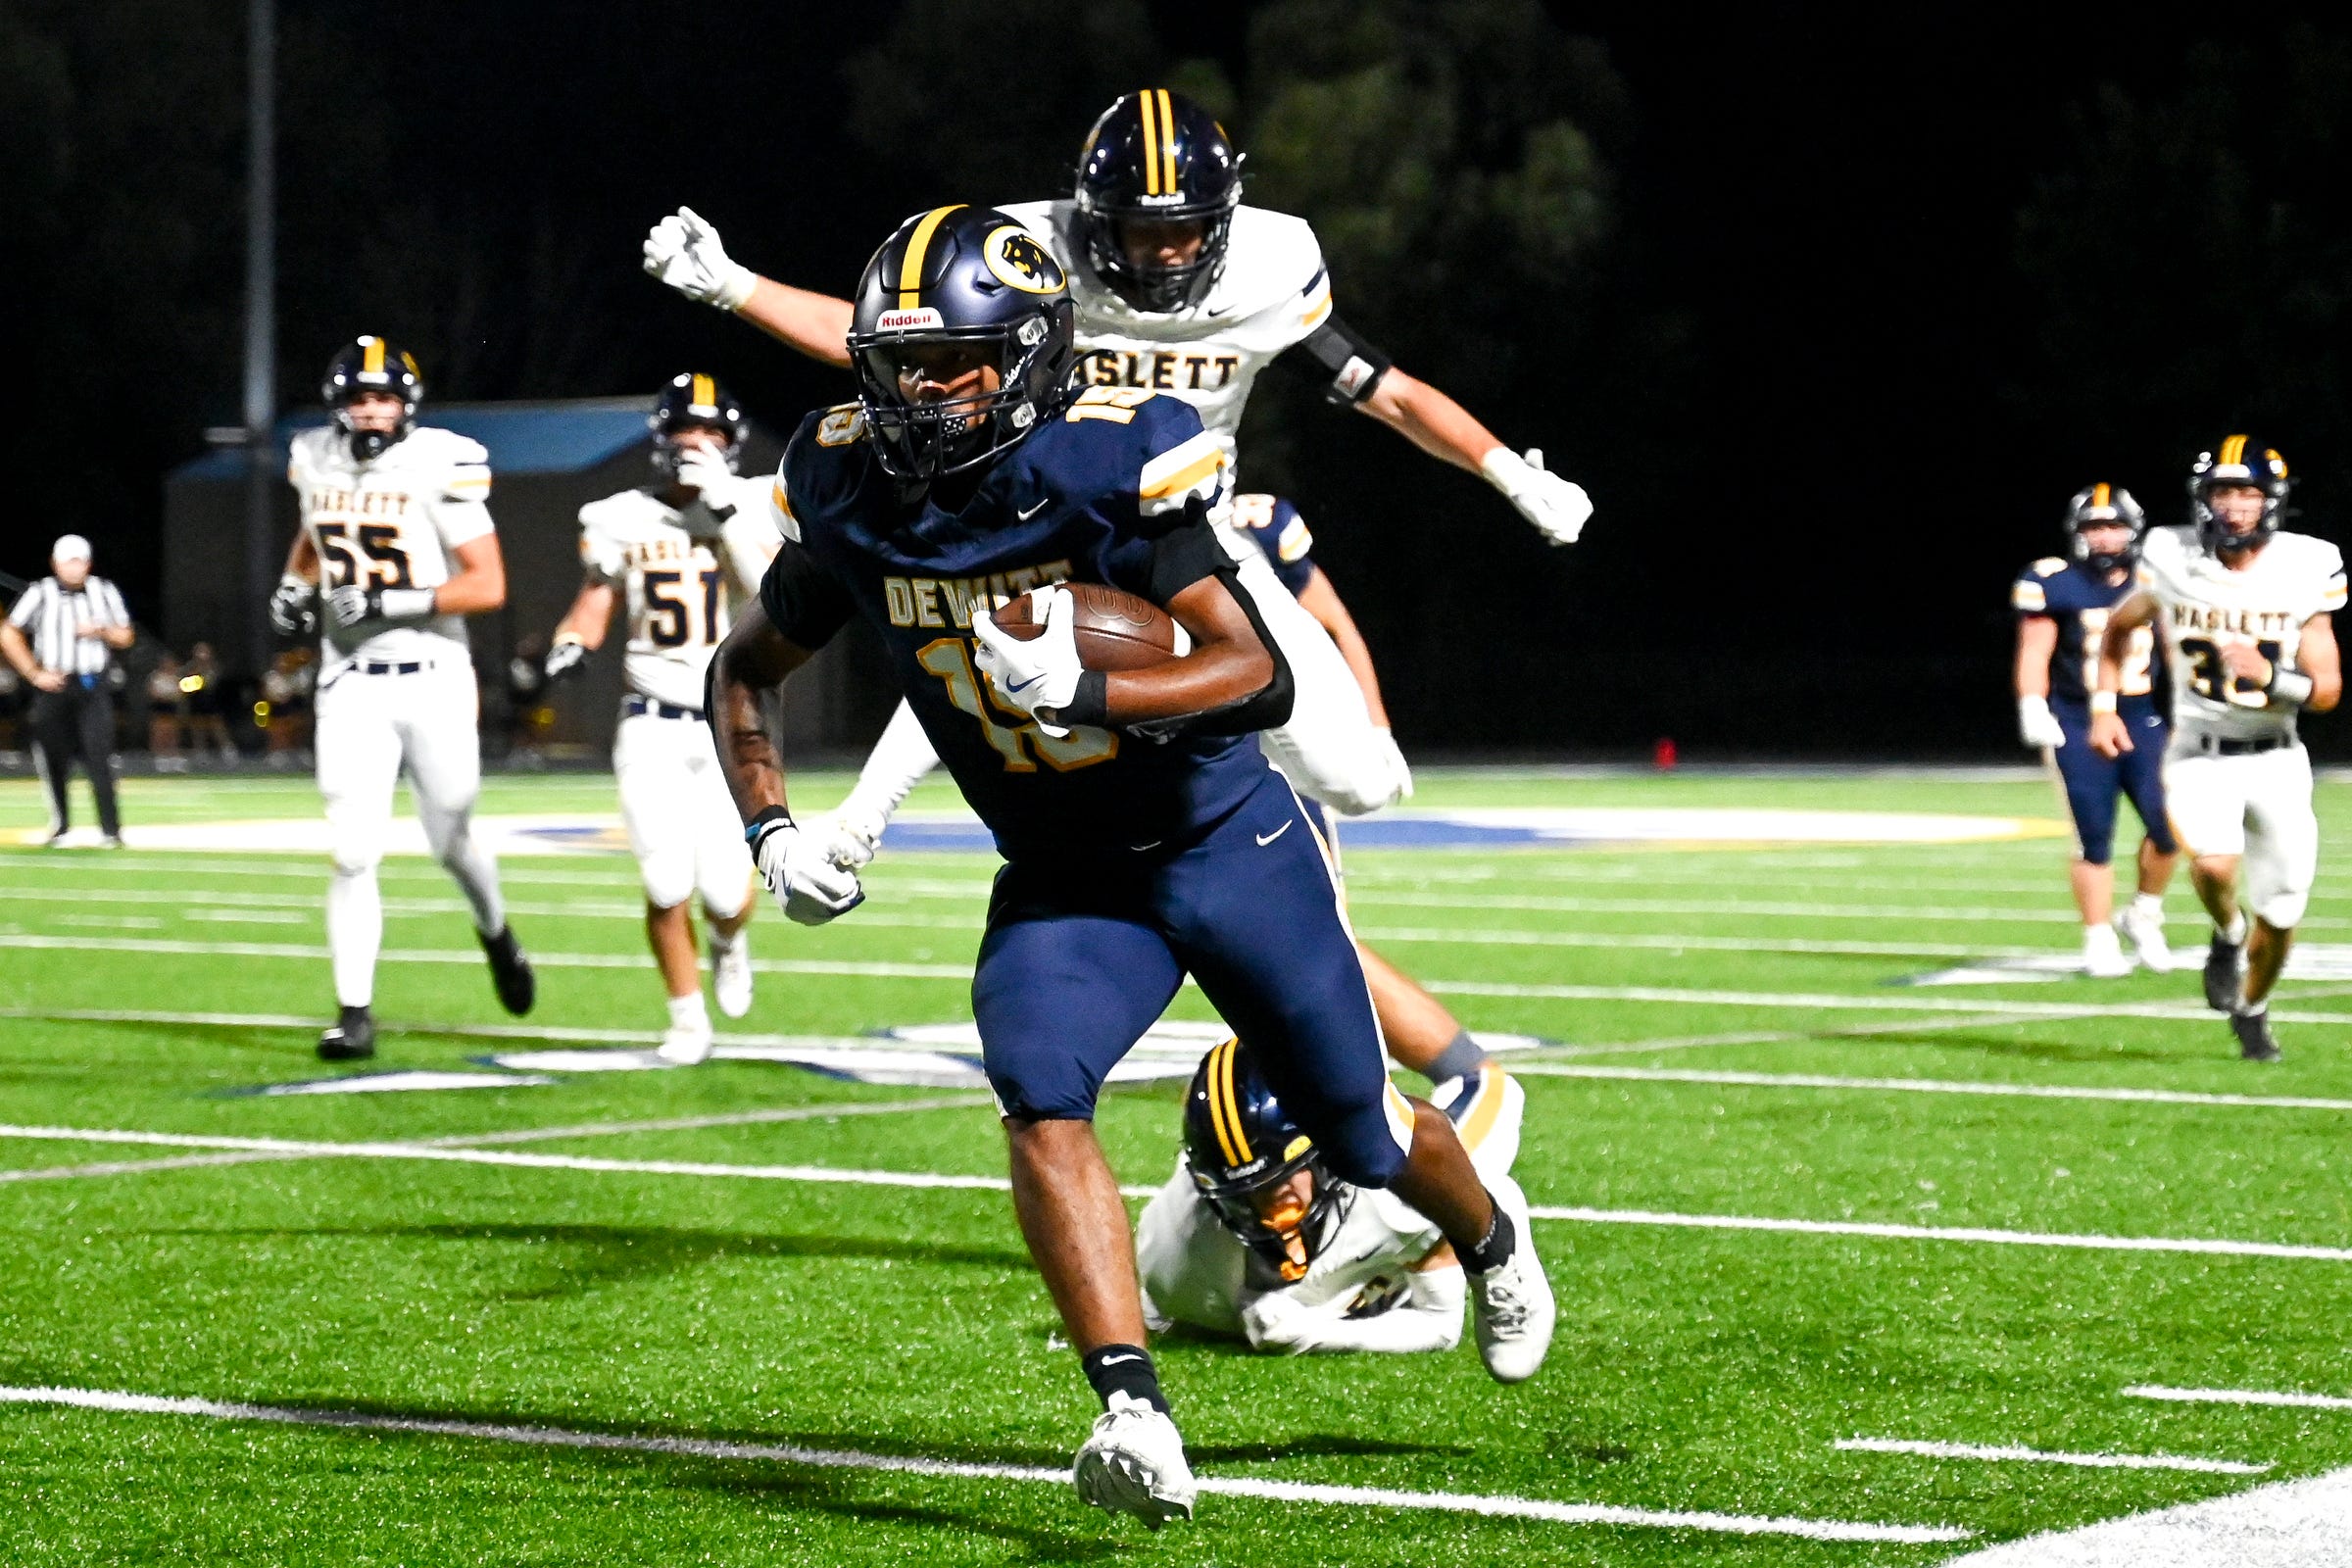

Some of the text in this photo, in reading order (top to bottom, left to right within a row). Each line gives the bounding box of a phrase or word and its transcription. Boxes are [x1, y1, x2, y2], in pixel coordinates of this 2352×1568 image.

[316, 520, 416, 590] 55
[643, 569, 722, 647] 51
[2173, 606, 2291, 634] HASLETT
